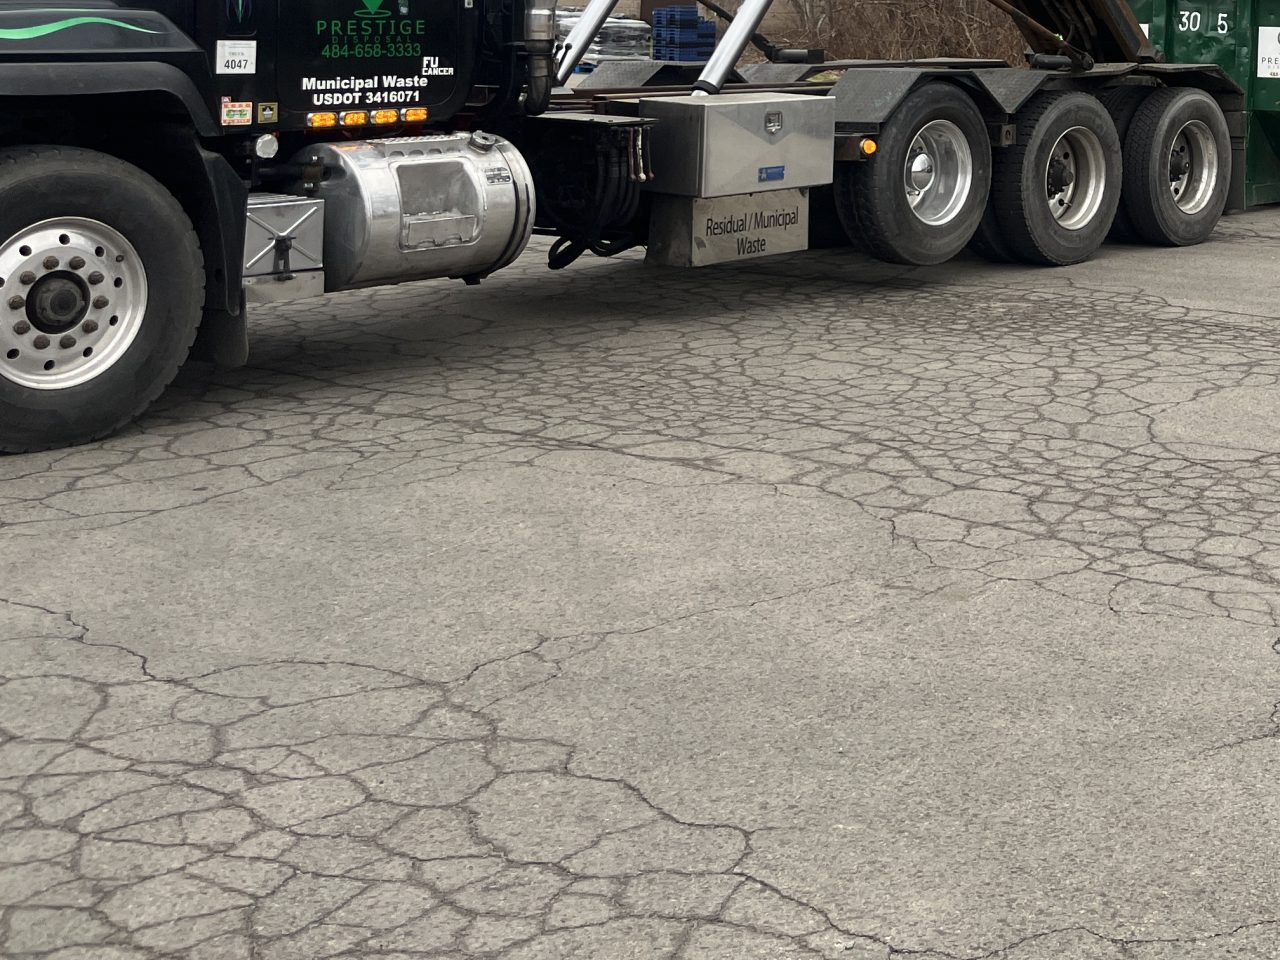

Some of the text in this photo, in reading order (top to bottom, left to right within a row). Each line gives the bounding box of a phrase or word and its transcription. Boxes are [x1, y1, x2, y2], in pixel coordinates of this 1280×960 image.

[317, 20, 425, 35] PRESTIGE
[1178, 11, 1228, 34] 30 5
[322, 43, 421, 58] 484-658-3333
[224, 59, 248, 69] 4047
[423, 56, 439, 68] FU
[422, 67, 454, 75] CANCER
[302, 75, 428, 90] Municipal Waste
[313, 90, 420, 105] USDOT 3416071
[706, 212, 747, 237] Residual
[754, 206, 799, 231] Municipal
[737, 237, 766, 256] Waste
